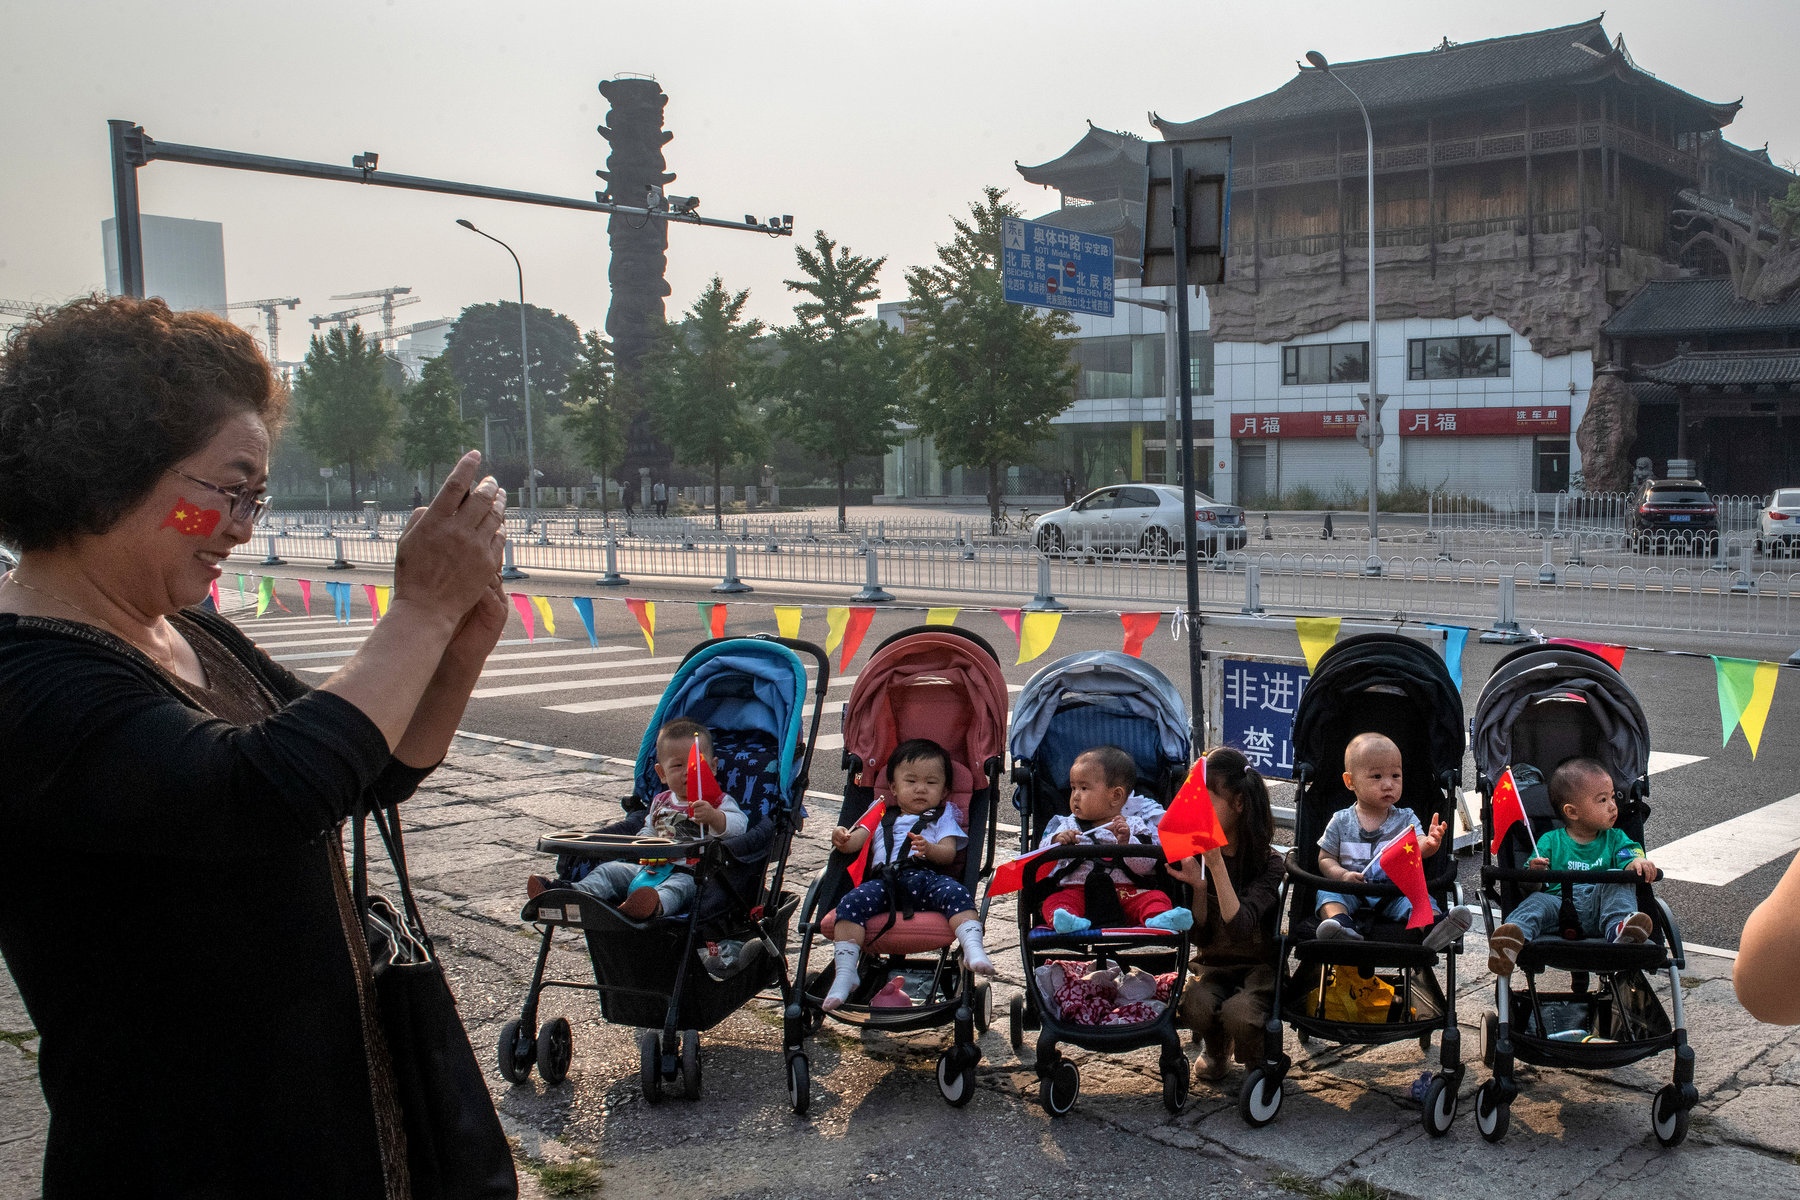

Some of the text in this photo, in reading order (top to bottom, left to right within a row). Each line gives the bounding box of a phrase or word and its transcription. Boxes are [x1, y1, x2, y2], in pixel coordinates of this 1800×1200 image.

[1008, 222, 1017, 235] 东
[1035, 246, 1049, 256] AOTI
[1052, 248, 1071, 258] Middle
[1006, 251, 1046, 272] 北辰路
[1006, 267, 1034, 279] BEICHEN
[1076, 271, 1113, 291] 北辰路
[1076, 287, 1102, 298] BEICHEN
[1516, 410, 1558, 419] 洗车机
[1239, 417, 1280, 434] 月福
[1408, 413, 1456, 432] 月福
[1225, 669, 1312, 714] 非进
[1568, 860, 1590, 871] SUPER
